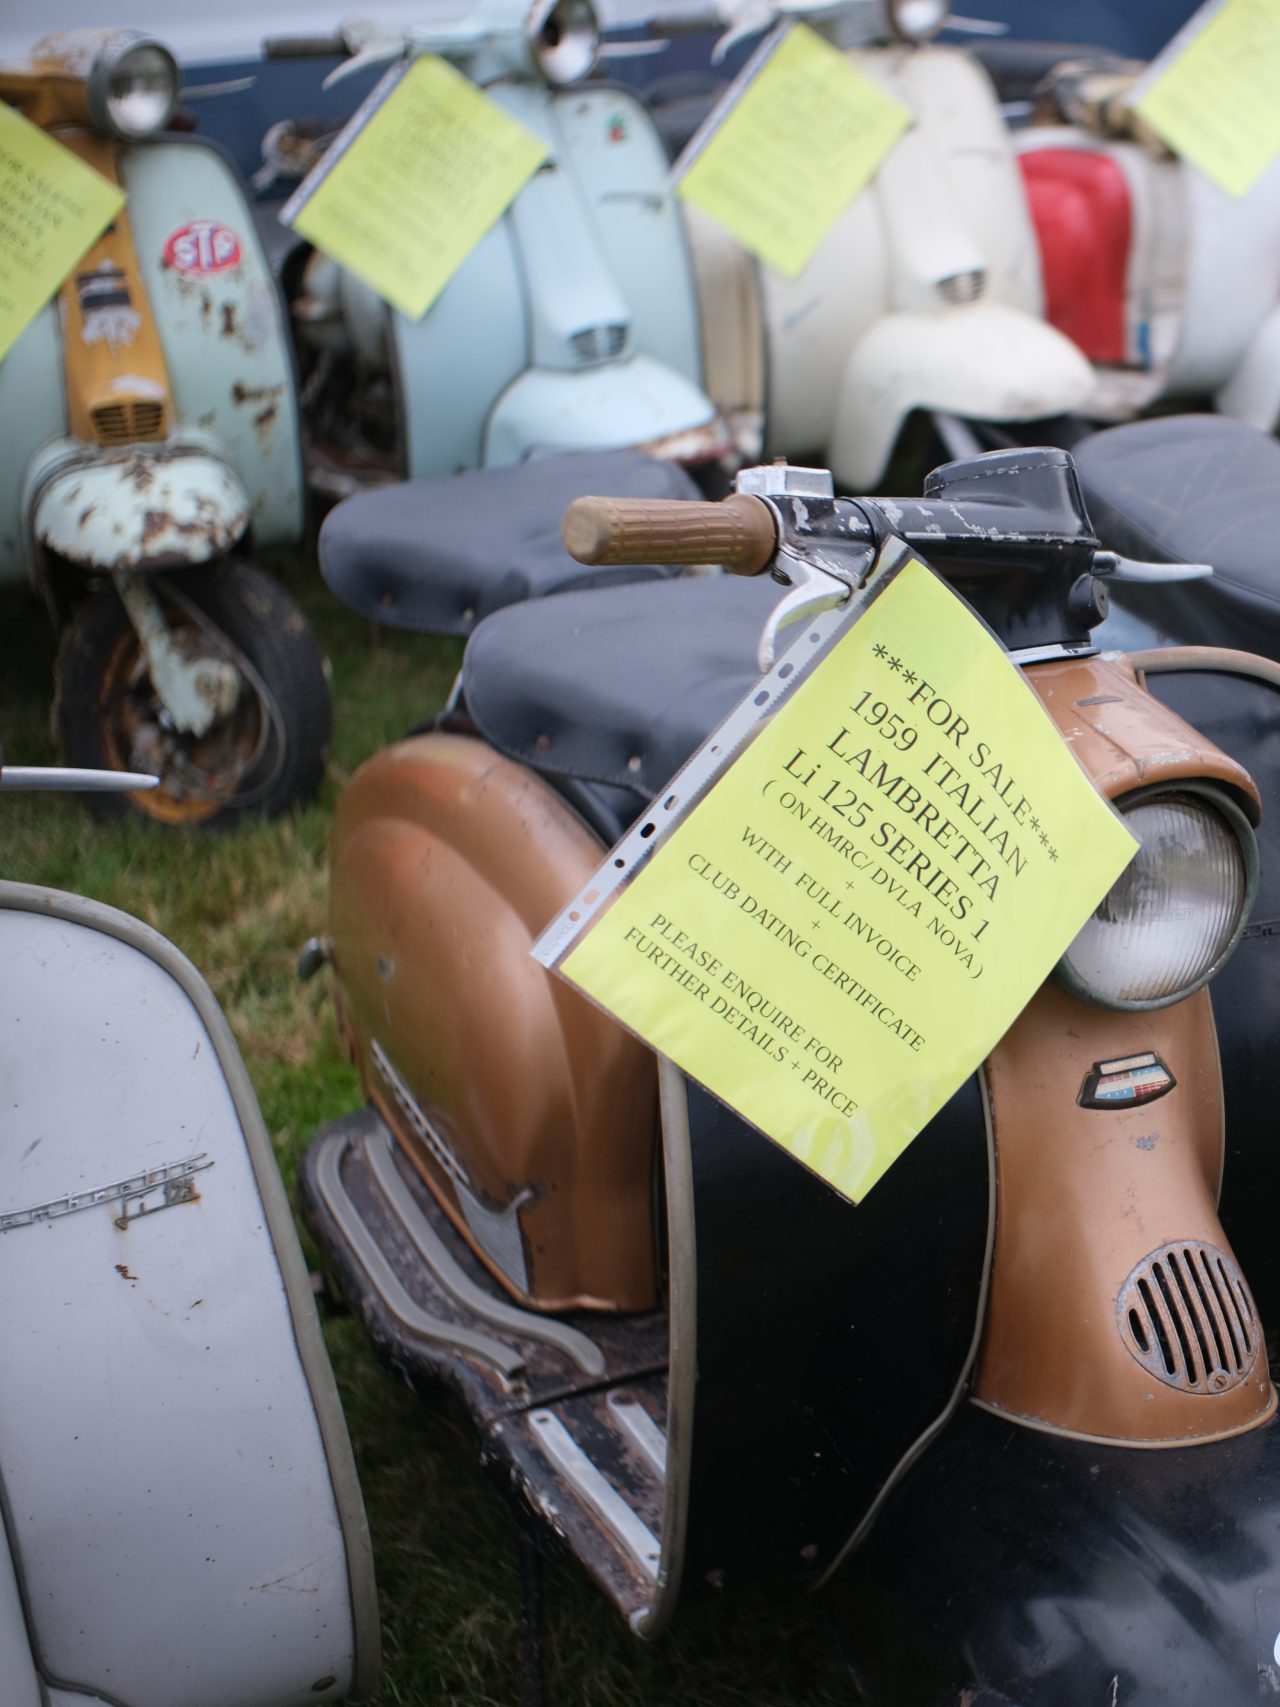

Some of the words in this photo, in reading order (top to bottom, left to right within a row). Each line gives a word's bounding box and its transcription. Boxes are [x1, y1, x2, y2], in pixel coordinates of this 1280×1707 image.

[174, 221, 236, 269] STP
[782, 748, 821, 787] Li
[818, 780, 874, 827] 125
[870, 822, 973, 919] SERIES
[971, 919, 989, 943] 1
[826, 726, 999, 902] LAMBRETTA
[850, 691, 918, 751] 1959
[922, 752, 1027, 877] ITALIAN
[688, 854, 740, 899] CLUB
[739, 895, 812, 957] DATING
[812, 955, 925, 1052] CERTIFICATE
[742, 826, 793, 874] WITH
[795, 872, 842, 918] FULL
[842, 912, 921, 982] INVOICE
[780, 792, 811, 821] ON
[870, 867, 922, 918] DVLA
[926, 916, 973, 970] NOVA
[624, 926, 710, 1002] FURTHER
[709, 995, 789, 1061] DETAILS
[801, 1068, 858, 1118] PRICE
[650, 913, 723, 976] PLEASE
[720, 971, 806, 1043] ENQUIRE
[803, 1036, 843, 1074] FOR
